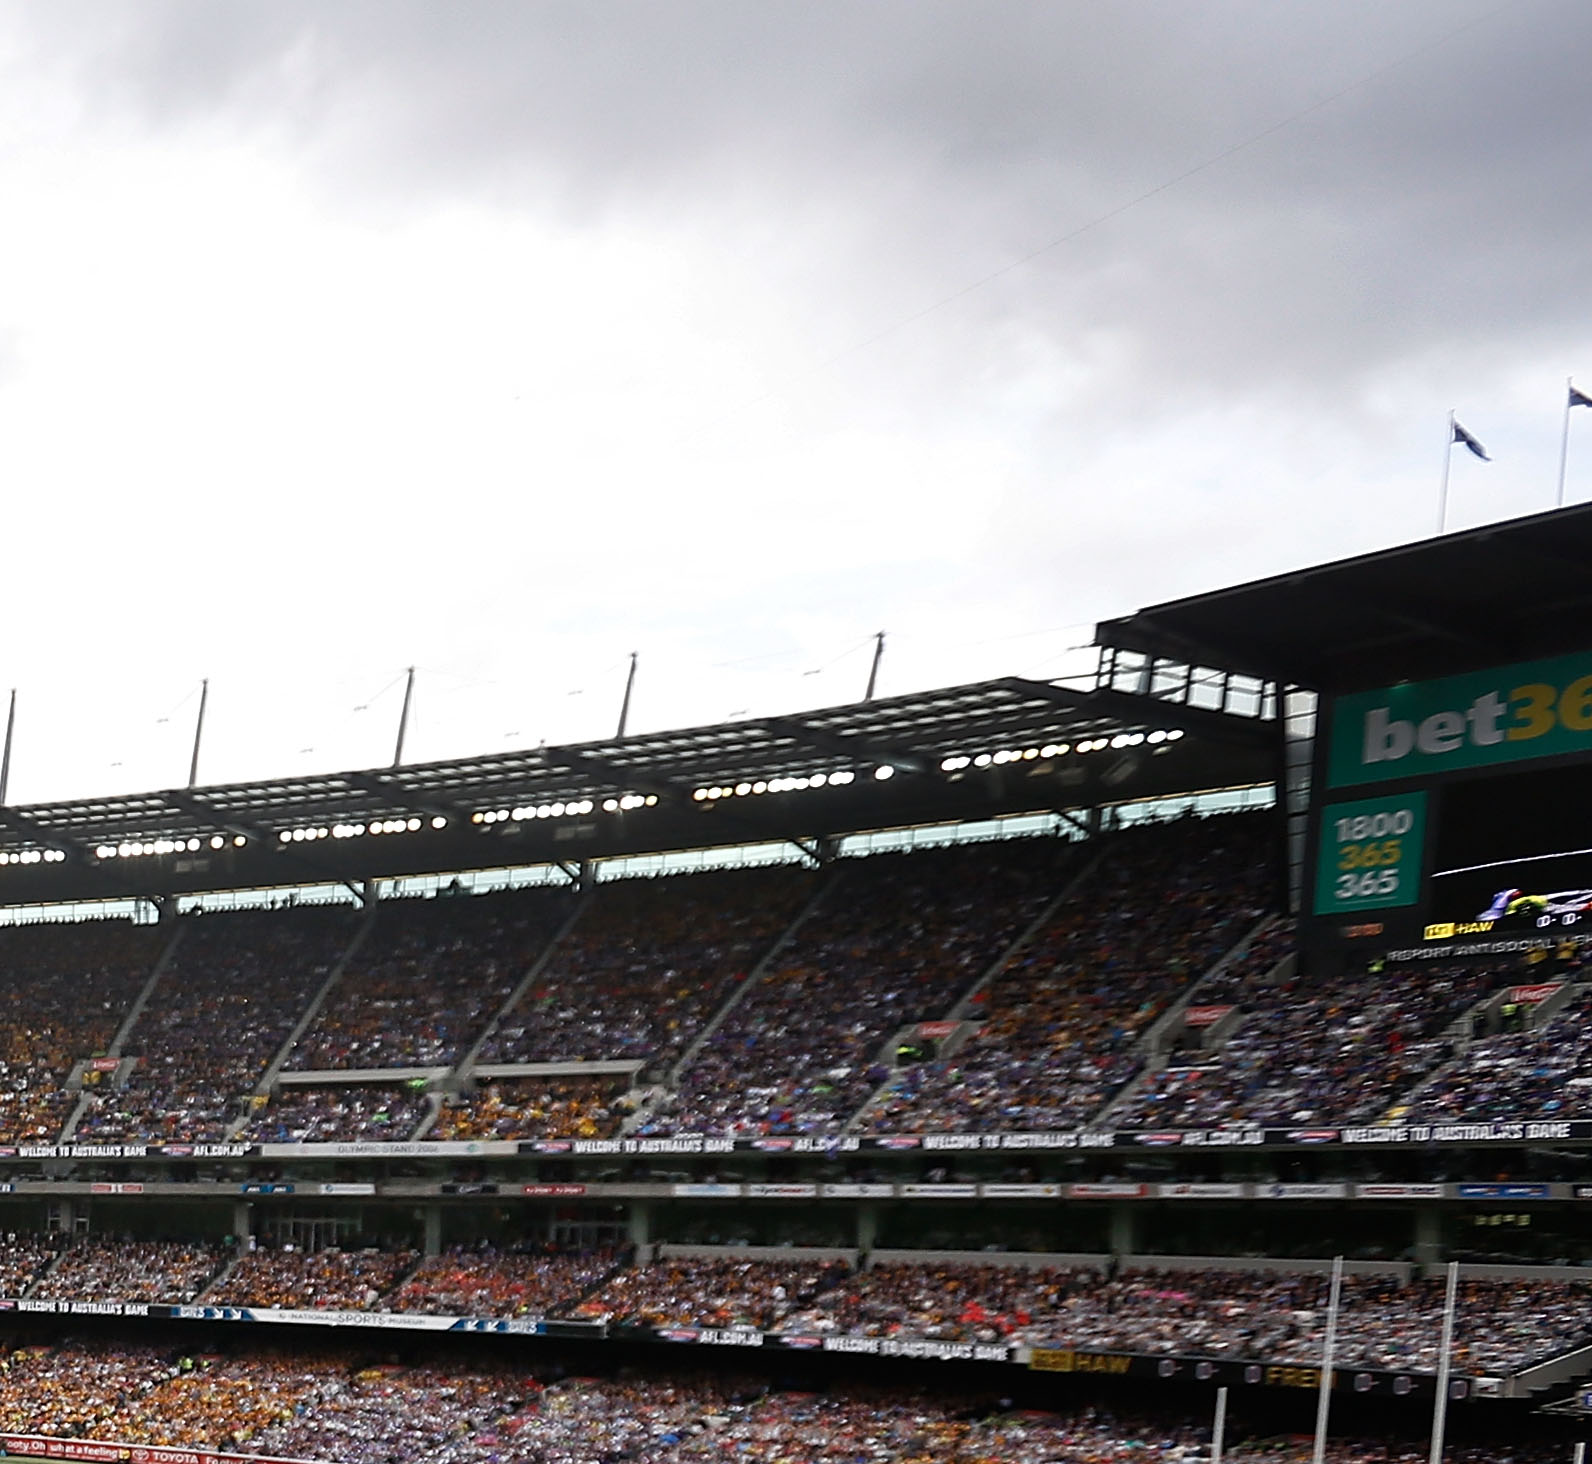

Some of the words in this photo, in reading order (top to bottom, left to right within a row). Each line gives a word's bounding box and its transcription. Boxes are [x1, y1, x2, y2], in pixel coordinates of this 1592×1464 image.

[1334, 809, 1414, 843] 1800
[1336, 839, 1401, 870] 365
[1333, 868, 1399, 899] 365
[1182, 1130, 1264, 1146] AFL.COM.AU
[1341, 1128, 1408, 1143] WELCOME
[1411, 1126, 1430, 1142] TO
[1432, 1124, 1524, 1141] AUSTRALIA'S
[1525, 1122, 1570, 1139] GAME
[382, 1144, 413, 1154] STAND
[575, 1141, 619, 1153] WELCOME
[622, 1140, 635, 1152] TO
[638, 1140, 701, 1152] AUSTRALIA'S
[704, 1139, 734, 1151] GAME
[922, 1136, 981, 1150] WELCOME
[984, 1135, 998, 1148] TO
[1002, 1133, 1077, 1149] AUSTRALIA'S
[1078, 1132, 1115, 1147] GAME
[19, 1147, 56, 1157] WELCOME
[59, 1147, 69, 1157] TO
[71, 1146, 121, 1157] AUSTRALIA'S
[124, 1146, 147, 1157] GAME
[193, 1145, 246, 1157] AFL.COM.AU
[19, 1300, 55, 1312] WELCOME
[57, 1302, 69, 1313] TO
[71, 1302, 121, 1315] AUSTRALIA'S
[124, 1304, 149, 1316] GAME
[291, 1312, 335, 1322] NATIONAL
[338, 1312, 385, 1327] SPORTS
[700, 1331, 764, 1347] AFL.COM.AU
[824, 1338, 879, 1353] WELCOME
[881, 1340, 900, 1356] TO
[901, 1341, 973, 1360] AUSTRALIA'S
[974, 1346, 1008, 1361] GAME
[1076, 1354, 1131, 1374] HAW
[7, 1440, 32, 1452] ooty.
[32, 1440, 46, 1451] Oh
[50, 1443, 75, 1455] what
[154, 1451, 199, 1464] TOYOTA
